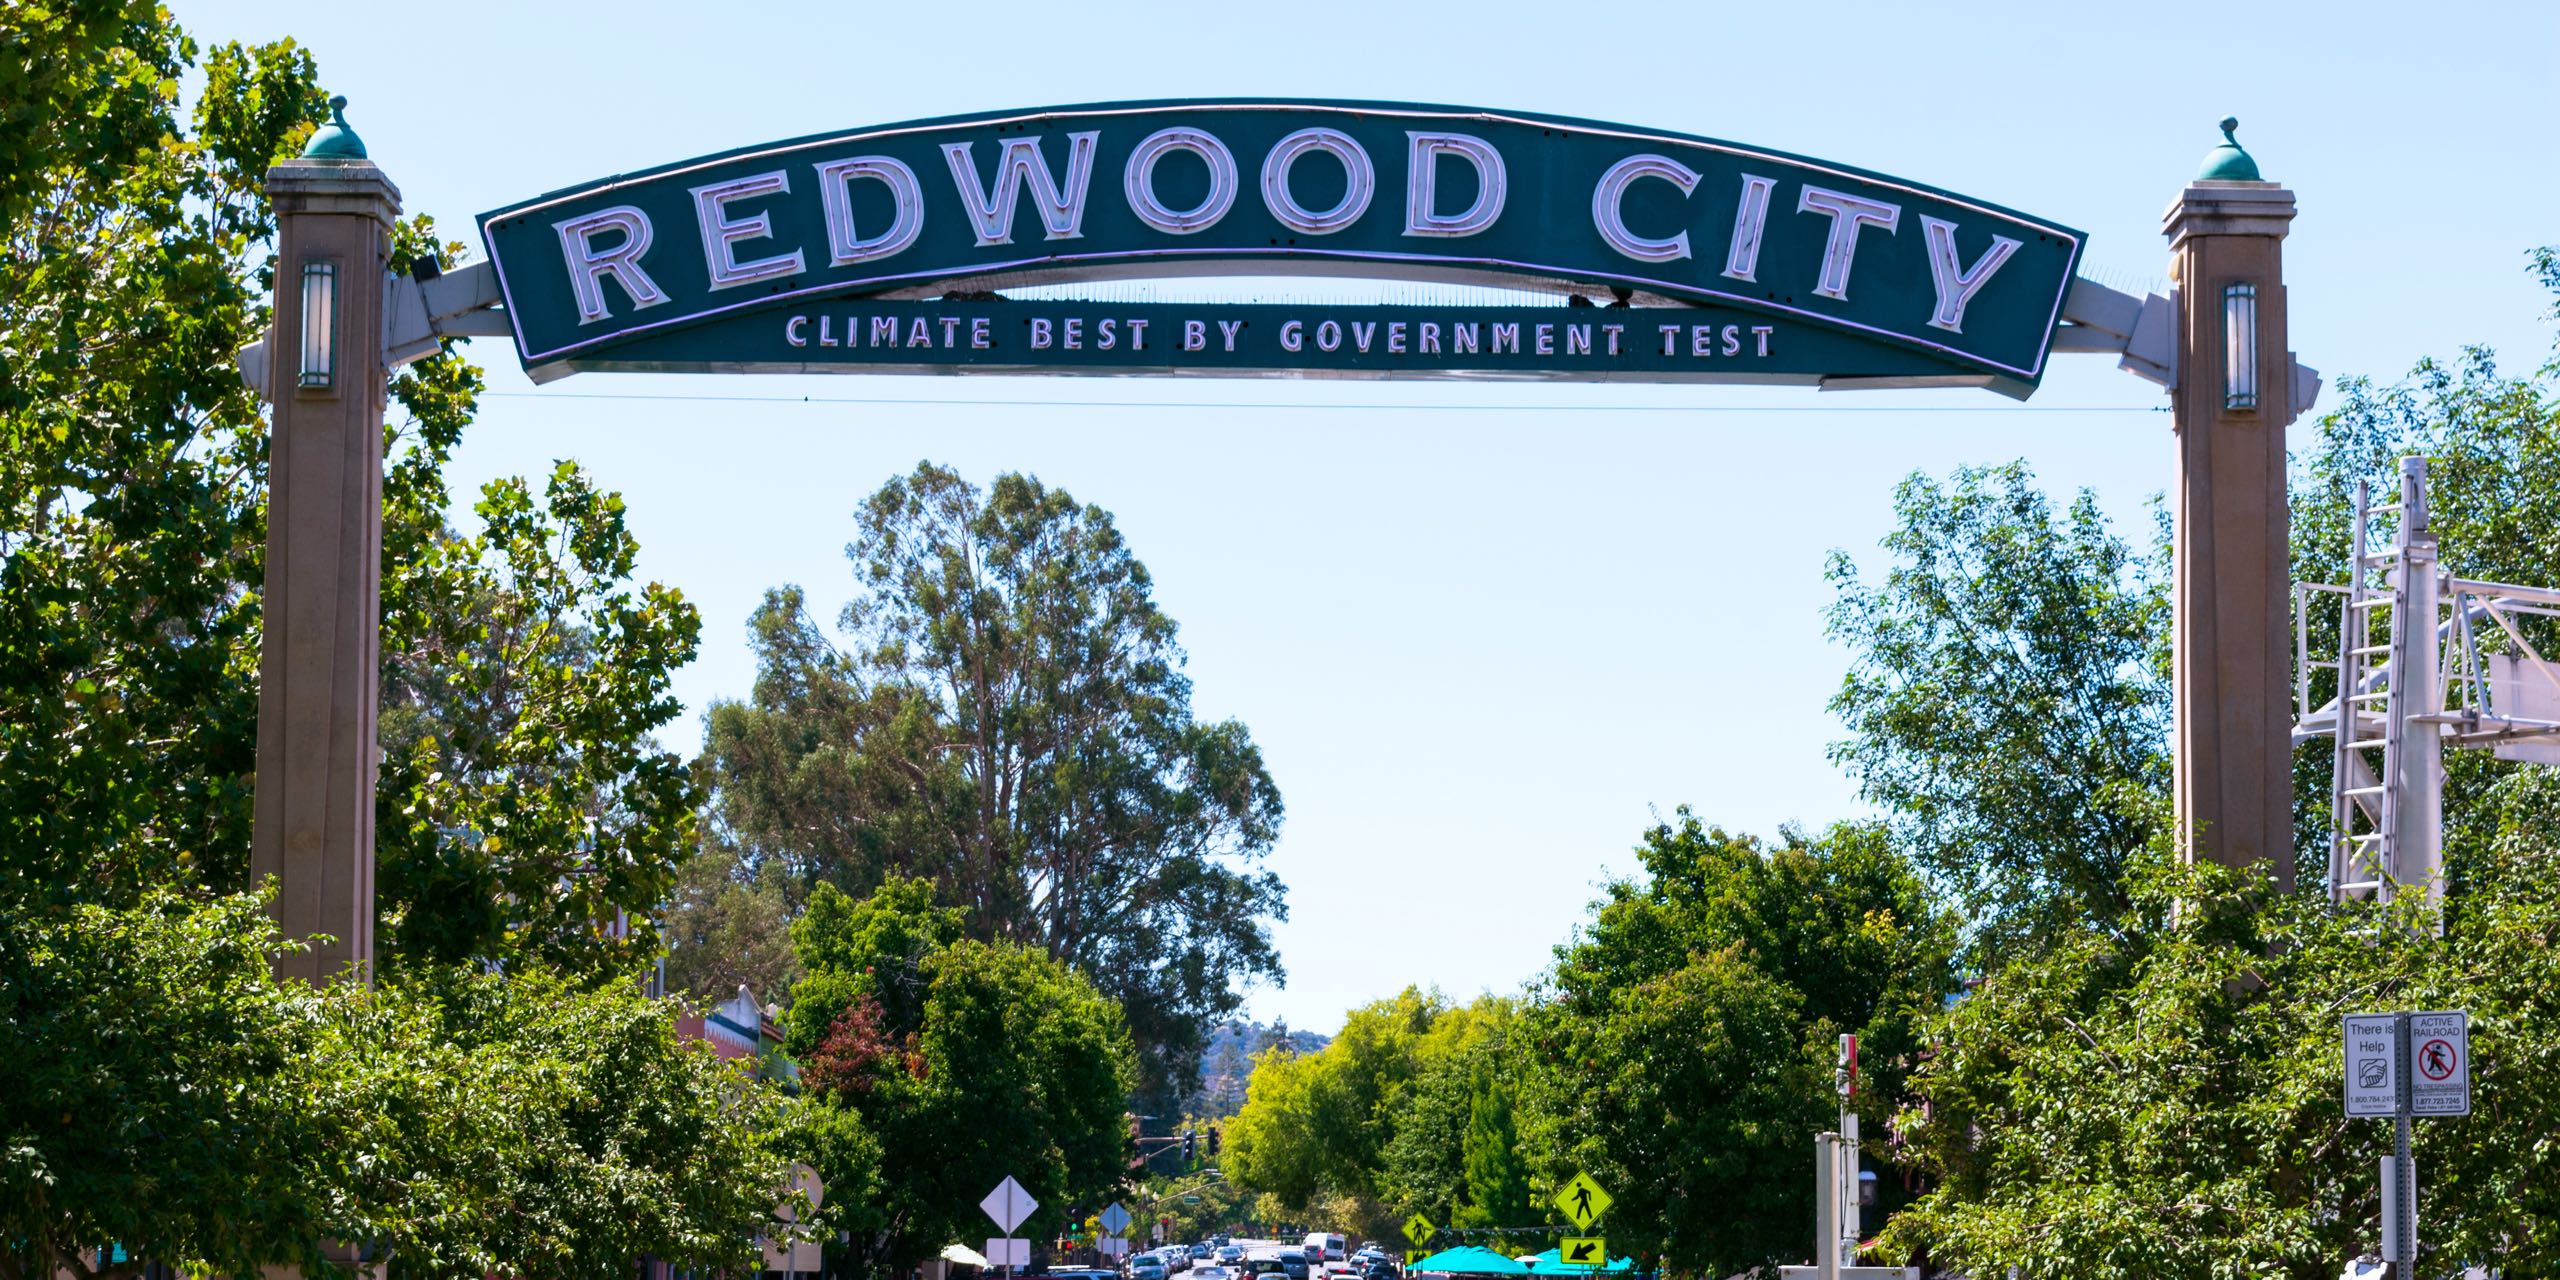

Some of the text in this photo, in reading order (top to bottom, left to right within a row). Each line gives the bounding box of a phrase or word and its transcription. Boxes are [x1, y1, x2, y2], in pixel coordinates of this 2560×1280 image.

[550, 126, 2023, 335] REDWOOD CITY
[785, 315, 1775, 357] CLIMATE BEST BY GOVERNMENT TEST
[2421, 1017, 2453, 1026] ACTIVE
[2350, 1023, 2394, 1035] There is
[2413, 1027, 2460, 1037] RAILROAD
[2359, 1040, 2385, 1053] Help
